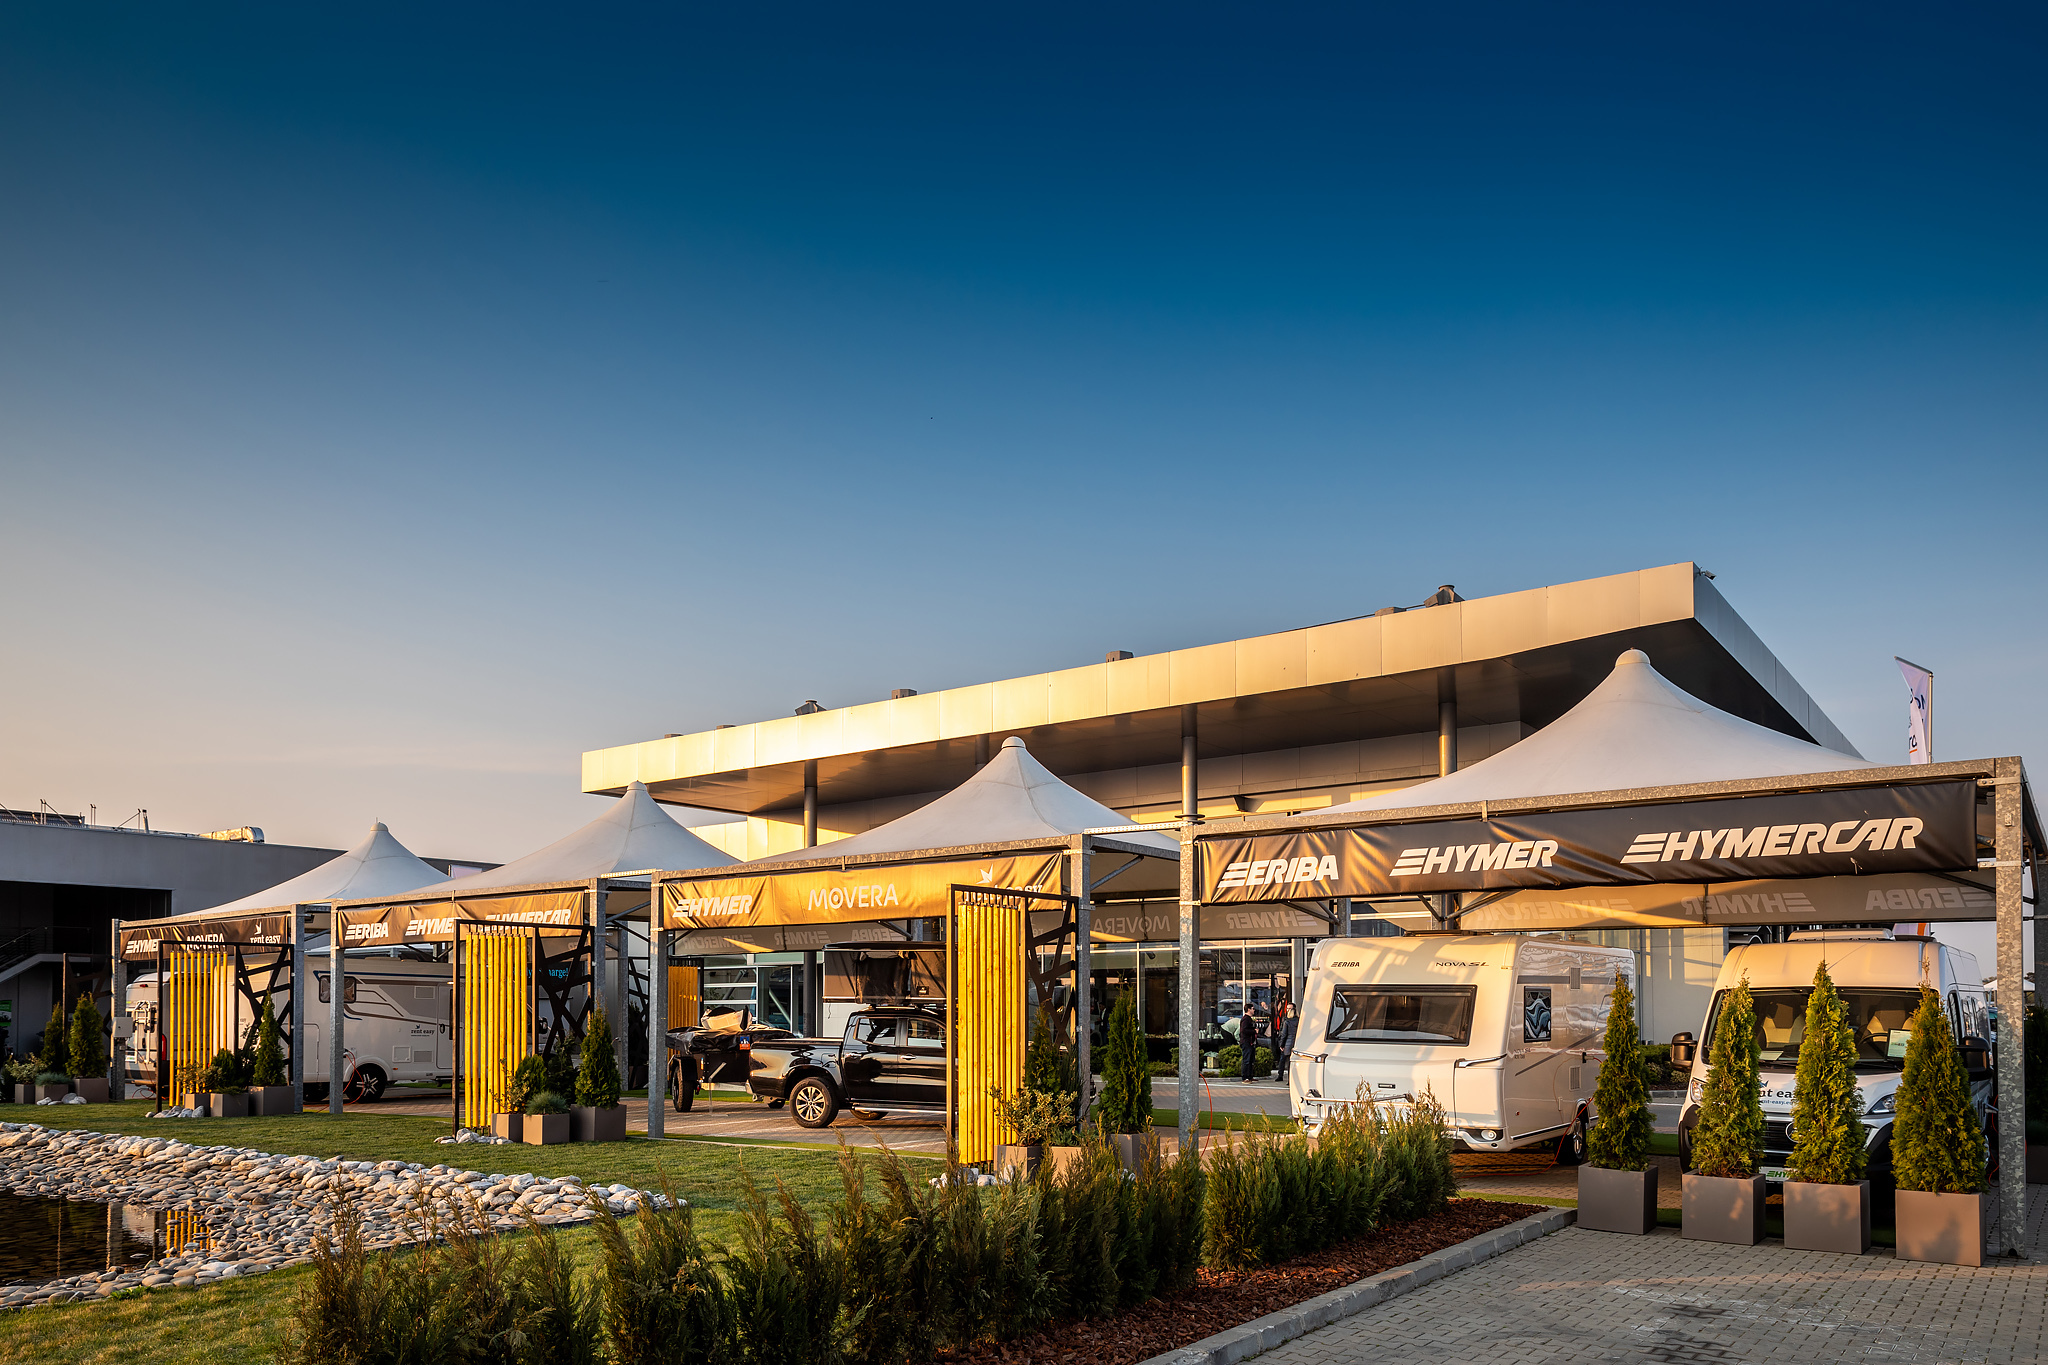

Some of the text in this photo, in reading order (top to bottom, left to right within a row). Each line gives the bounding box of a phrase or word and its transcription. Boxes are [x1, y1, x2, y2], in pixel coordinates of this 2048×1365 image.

[1245, 817, 1923, 886] ERIBA HYMER HYMERCAR
[689, 894, 753, 917] HYMER
[808, 884, 899, 910] MOVERA
[354, 922, 389, 939] ERIBA
[133, 939, 162, 953] HYME
